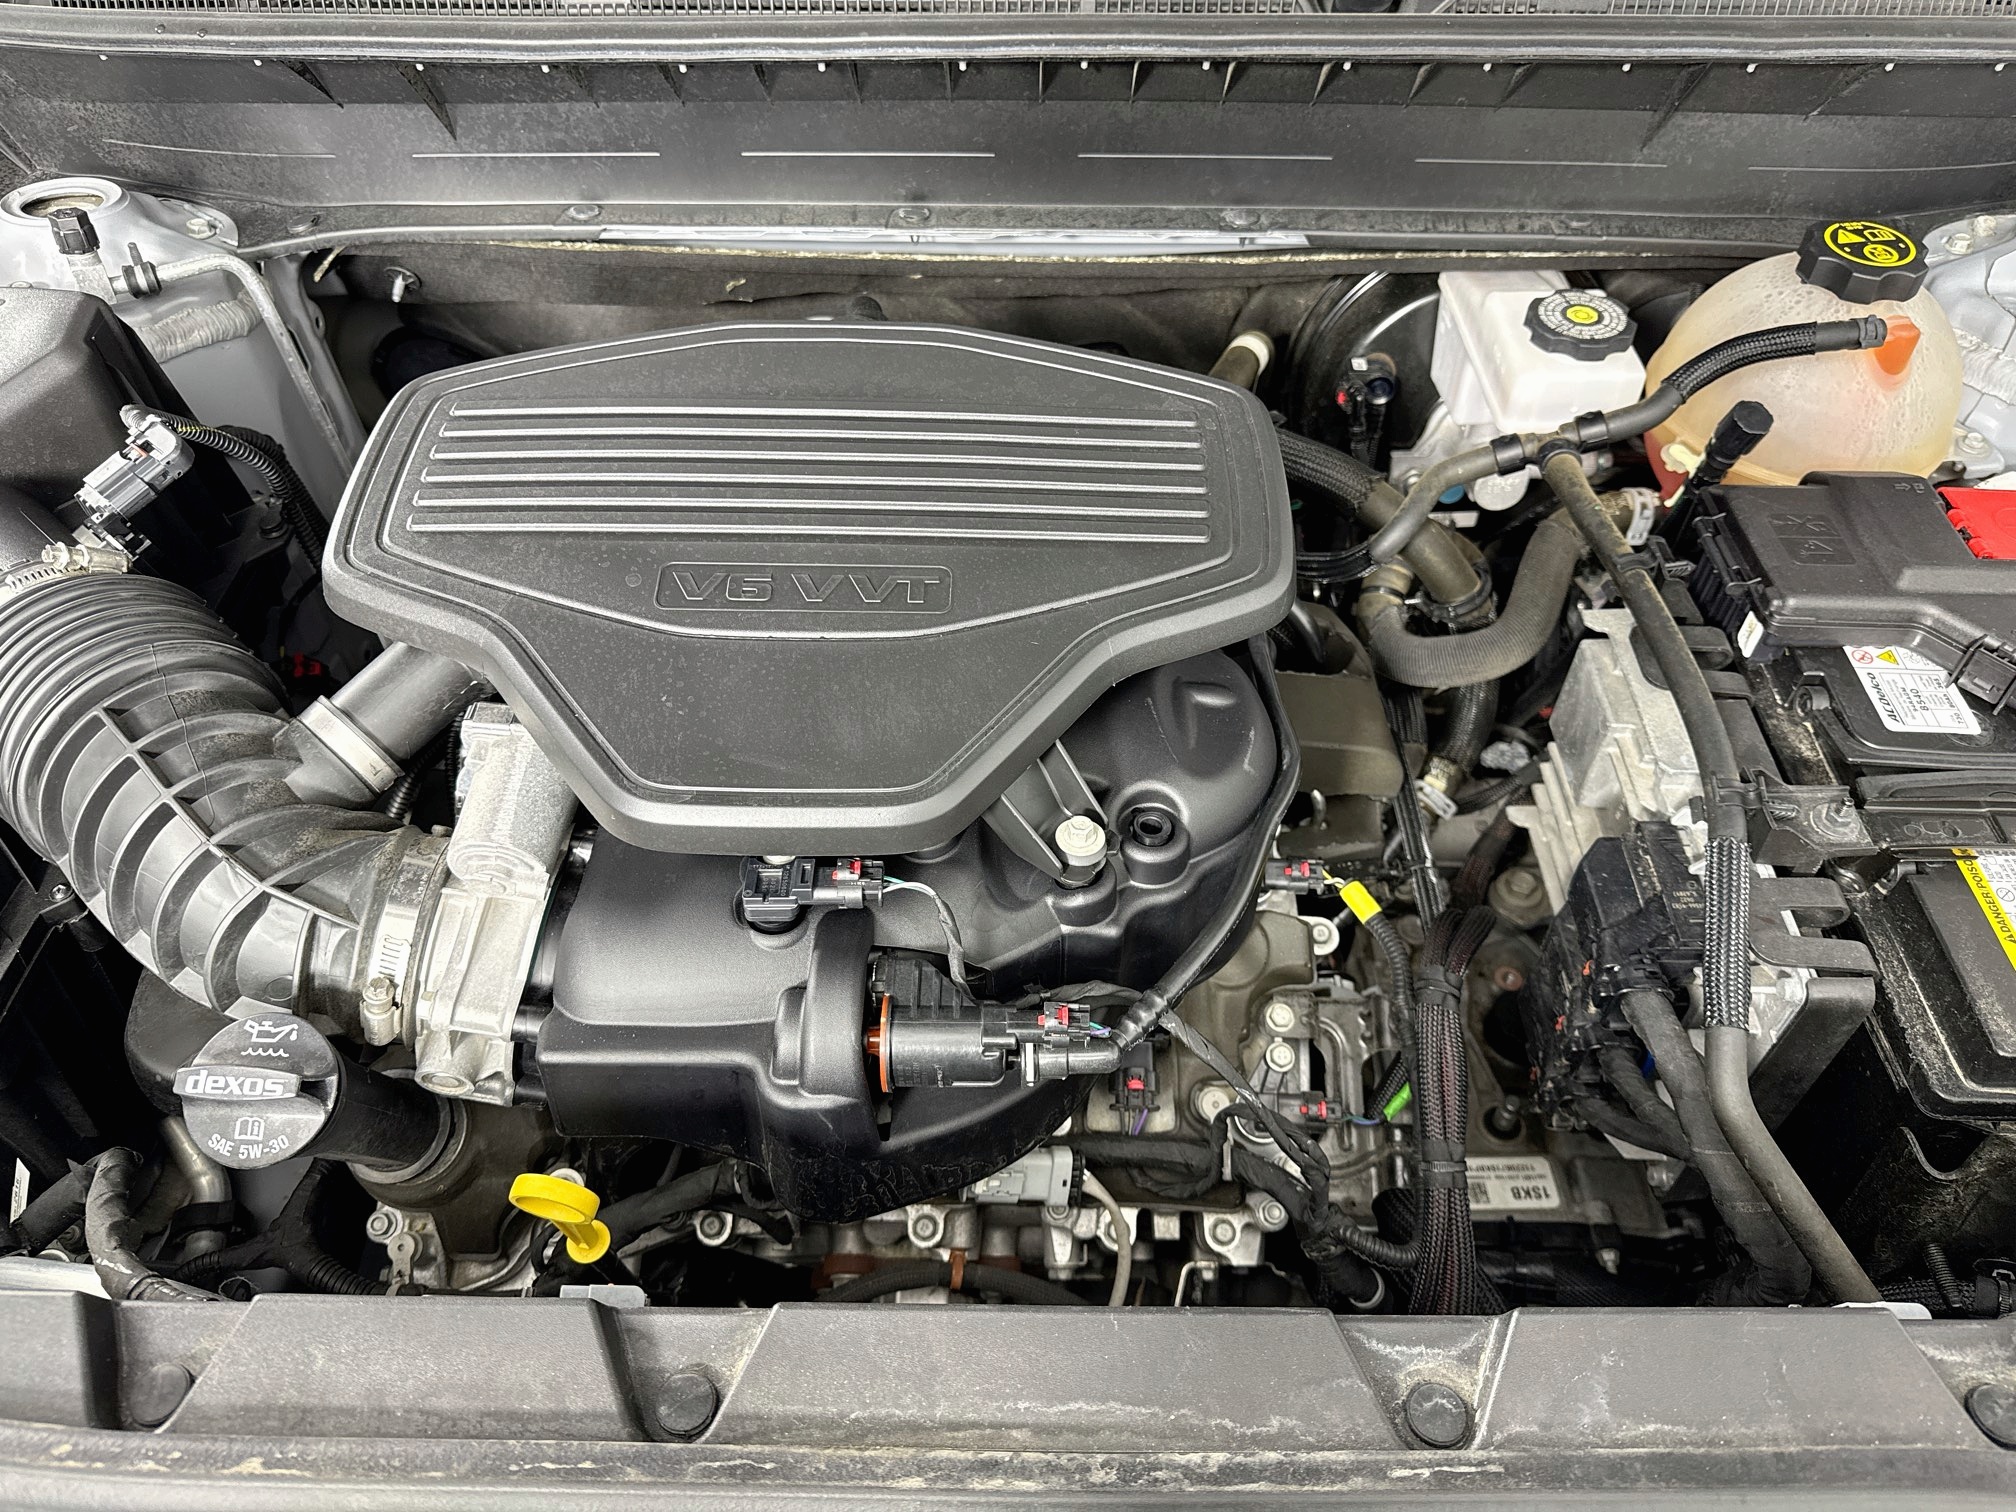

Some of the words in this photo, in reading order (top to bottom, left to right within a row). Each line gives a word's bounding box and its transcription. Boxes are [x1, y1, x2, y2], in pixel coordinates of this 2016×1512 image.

[672, 571, 774, 602] V6
[790, 573, 941, 604] VVT
[1867, 672, 1901, 724] ACDelco
[184, 1069, 285, 1097] dexos
[207, 1133, 235, 1157] SAE
[238, 1134, 289, 1160] 5W-30
